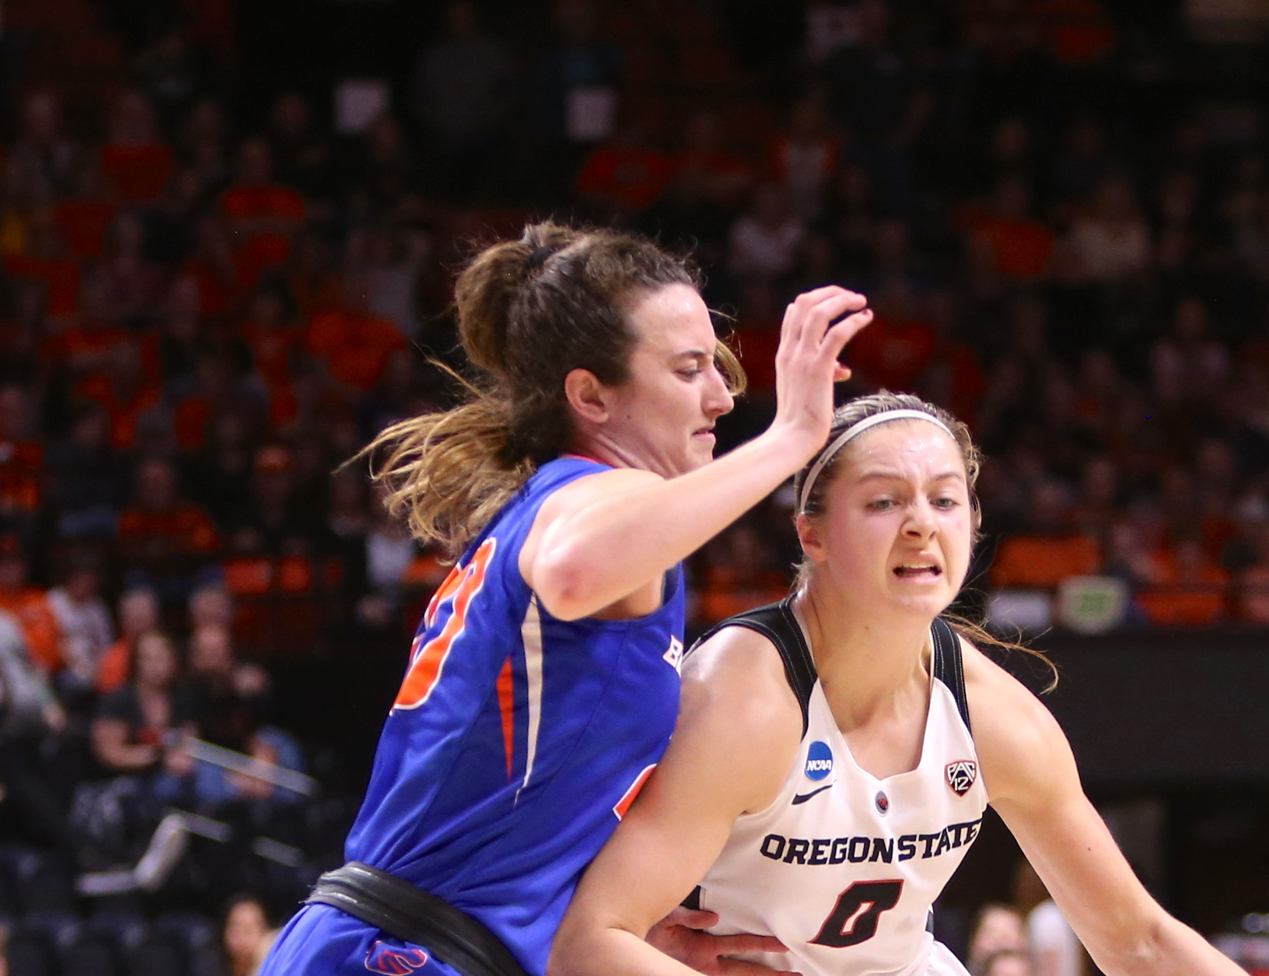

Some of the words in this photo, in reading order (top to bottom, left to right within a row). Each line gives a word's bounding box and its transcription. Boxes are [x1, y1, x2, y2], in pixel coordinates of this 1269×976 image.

[807, 759, 832, 772] NCAA
[946, 761, 976, 785] PAC
[954, 776, 970, 791] 12
[760, 833, 895, 866] OREGON
[897, 817, 983, 863] STATE
[806, 878, 905, 949] 0
